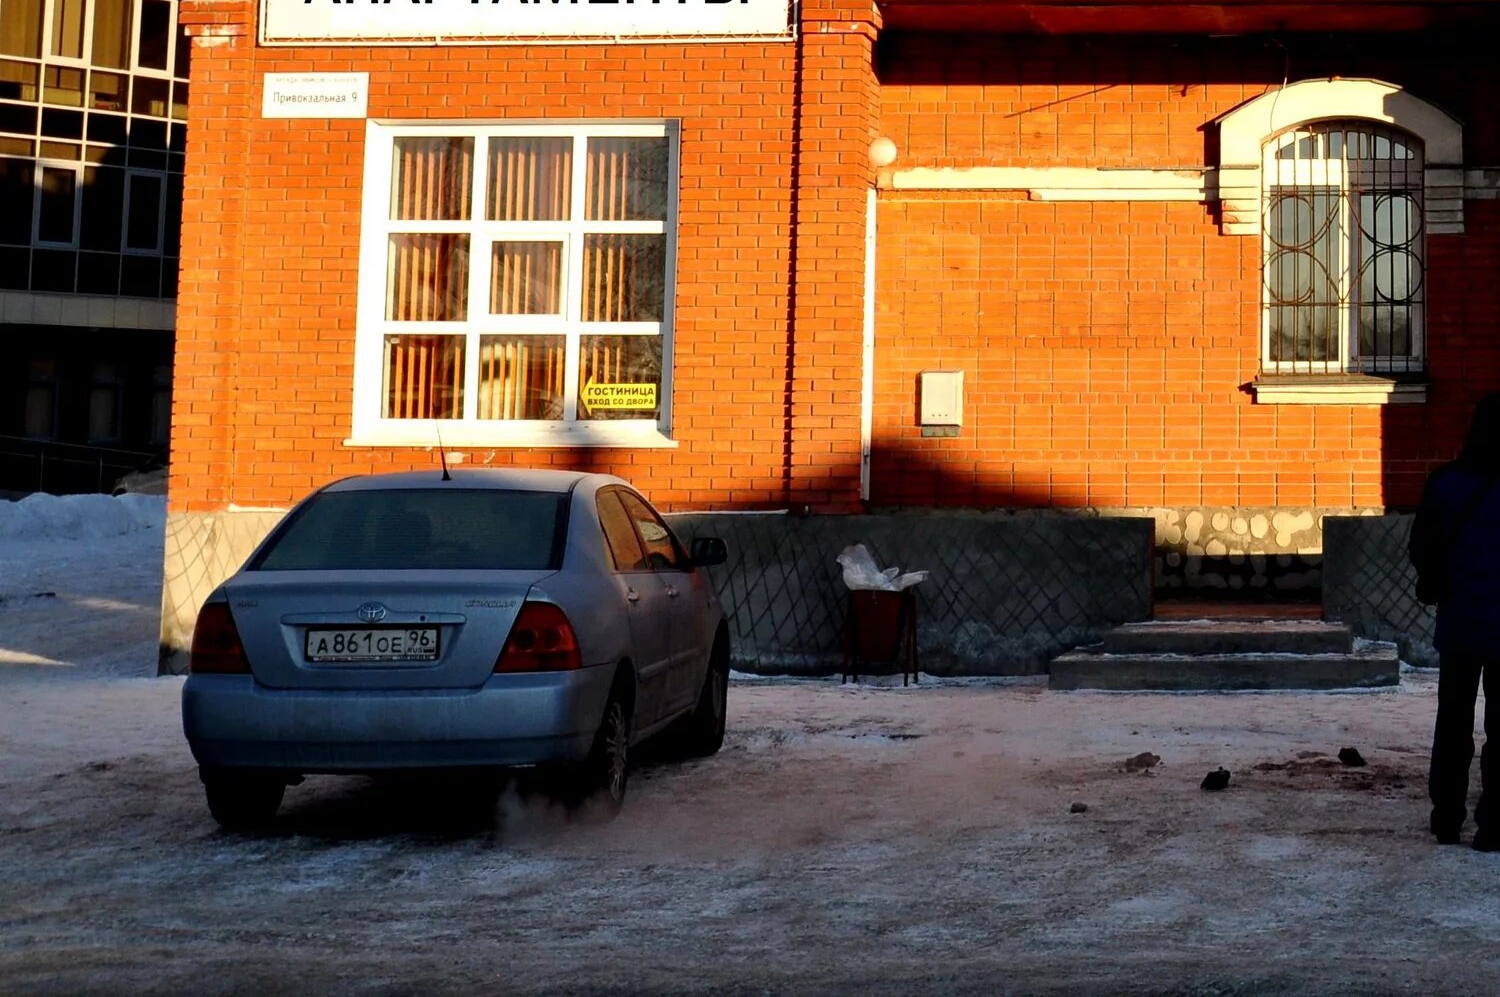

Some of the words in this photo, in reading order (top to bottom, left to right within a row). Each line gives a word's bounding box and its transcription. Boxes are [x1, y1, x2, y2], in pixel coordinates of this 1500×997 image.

[351, 91, 358, 103] 9
[587, 387, 655, 397] ГОСТИНИЦА
[587, 398, 610, 406] ВХОД
[626, 398, 654, 406] ДВОРА
